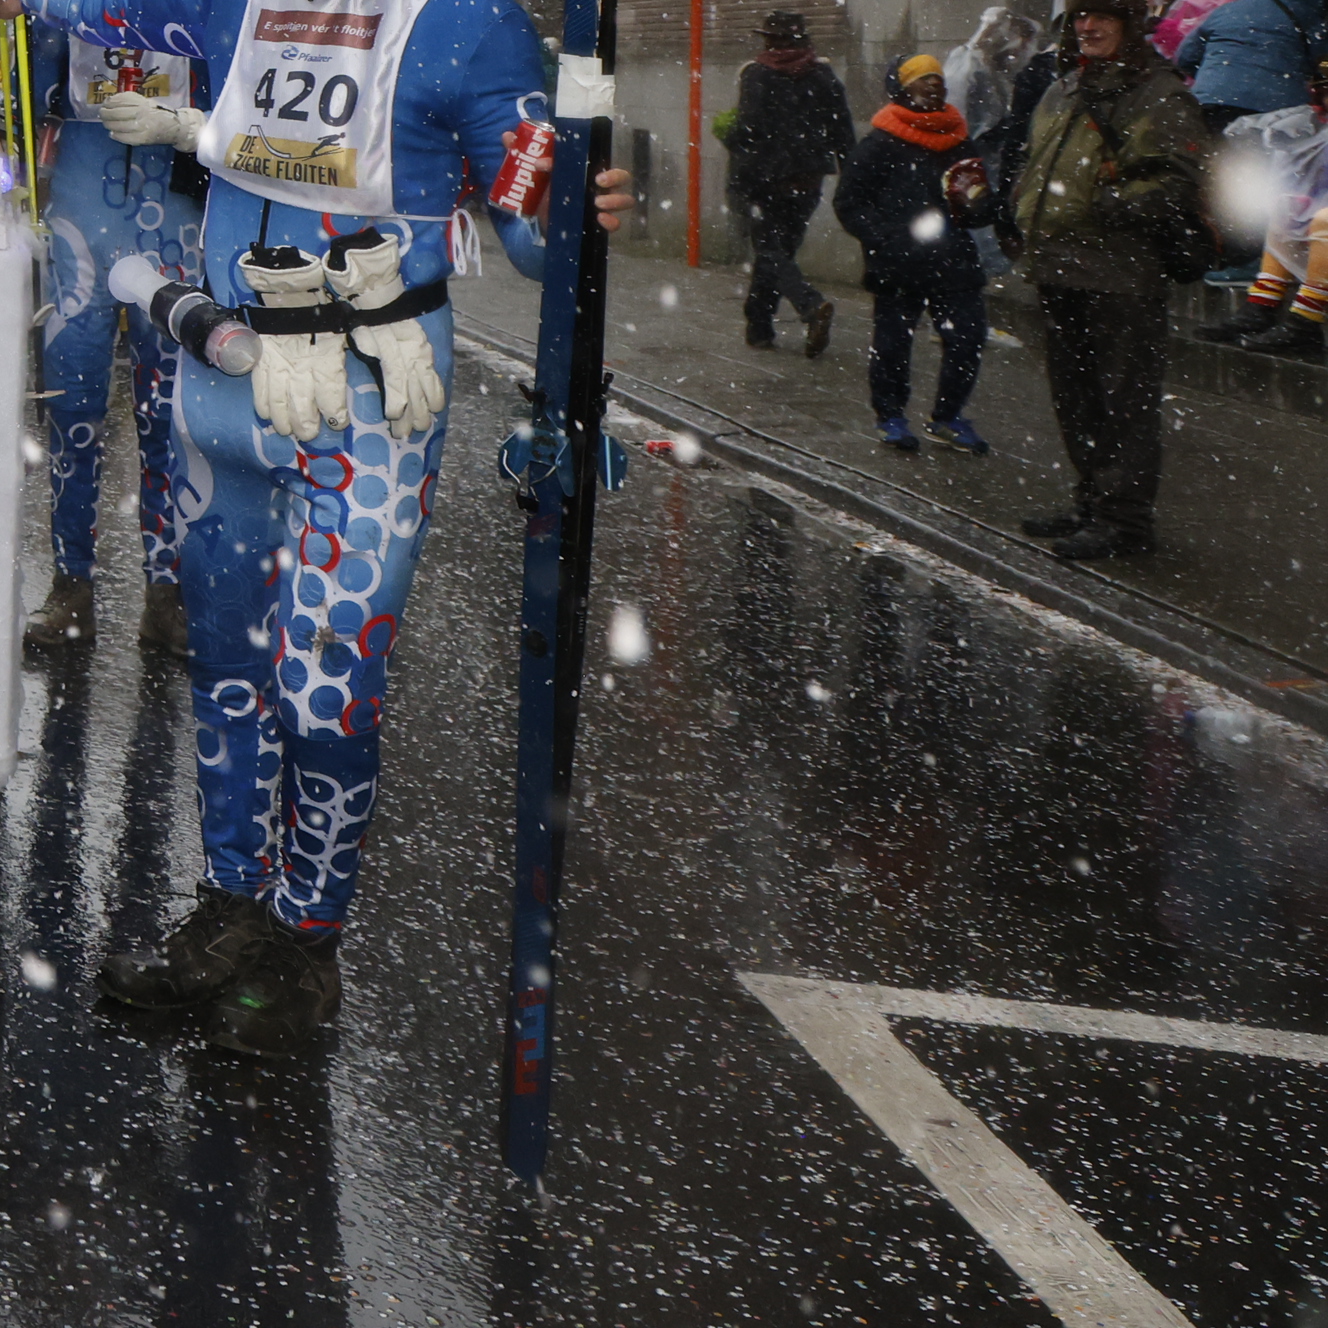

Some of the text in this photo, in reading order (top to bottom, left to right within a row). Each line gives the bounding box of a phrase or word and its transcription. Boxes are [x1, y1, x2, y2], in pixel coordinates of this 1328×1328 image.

[263, 21, 273, 30] E
[273, 21, 308, 33] spoitjen
[311, 23, 331, 34] vér
[332, 25, 340, 34] 't
[254, 68, 359, 127] 420
[238, 135, 256, 154] DE
[231, 154, 339, 187] ZIERE FLOITEN
[498, 128, 550, 218] Jupiler
